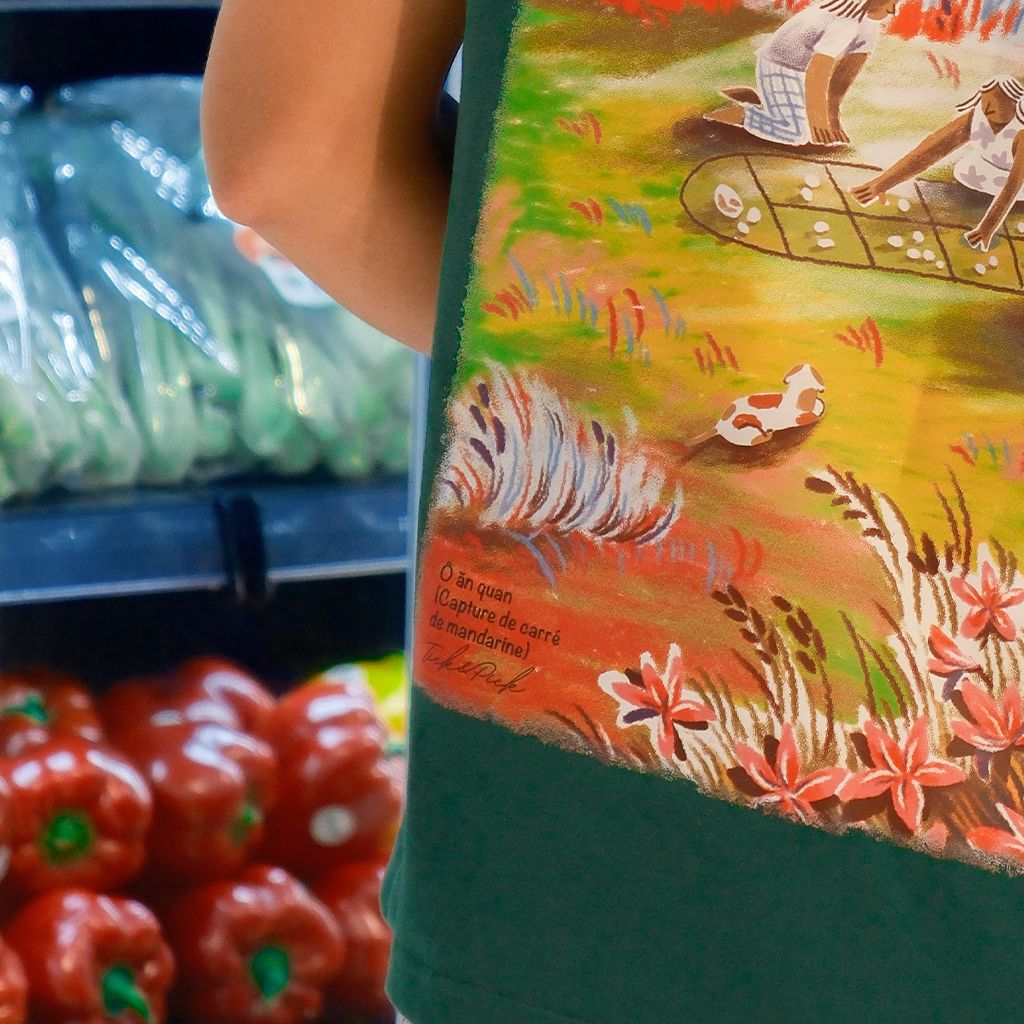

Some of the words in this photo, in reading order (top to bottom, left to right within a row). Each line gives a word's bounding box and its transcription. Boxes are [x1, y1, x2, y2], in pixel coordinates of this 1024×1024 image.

[456, 571, 474, 590] ăn
[477, 582, 513, 605] quan
[429, 610, 444, 631] de
[446, 621, 531, 660] mandarine)
[434, 585, 496, 624] (Capture
[499, 610, 517, 631] de
[519, 622, 561, 646] carré
